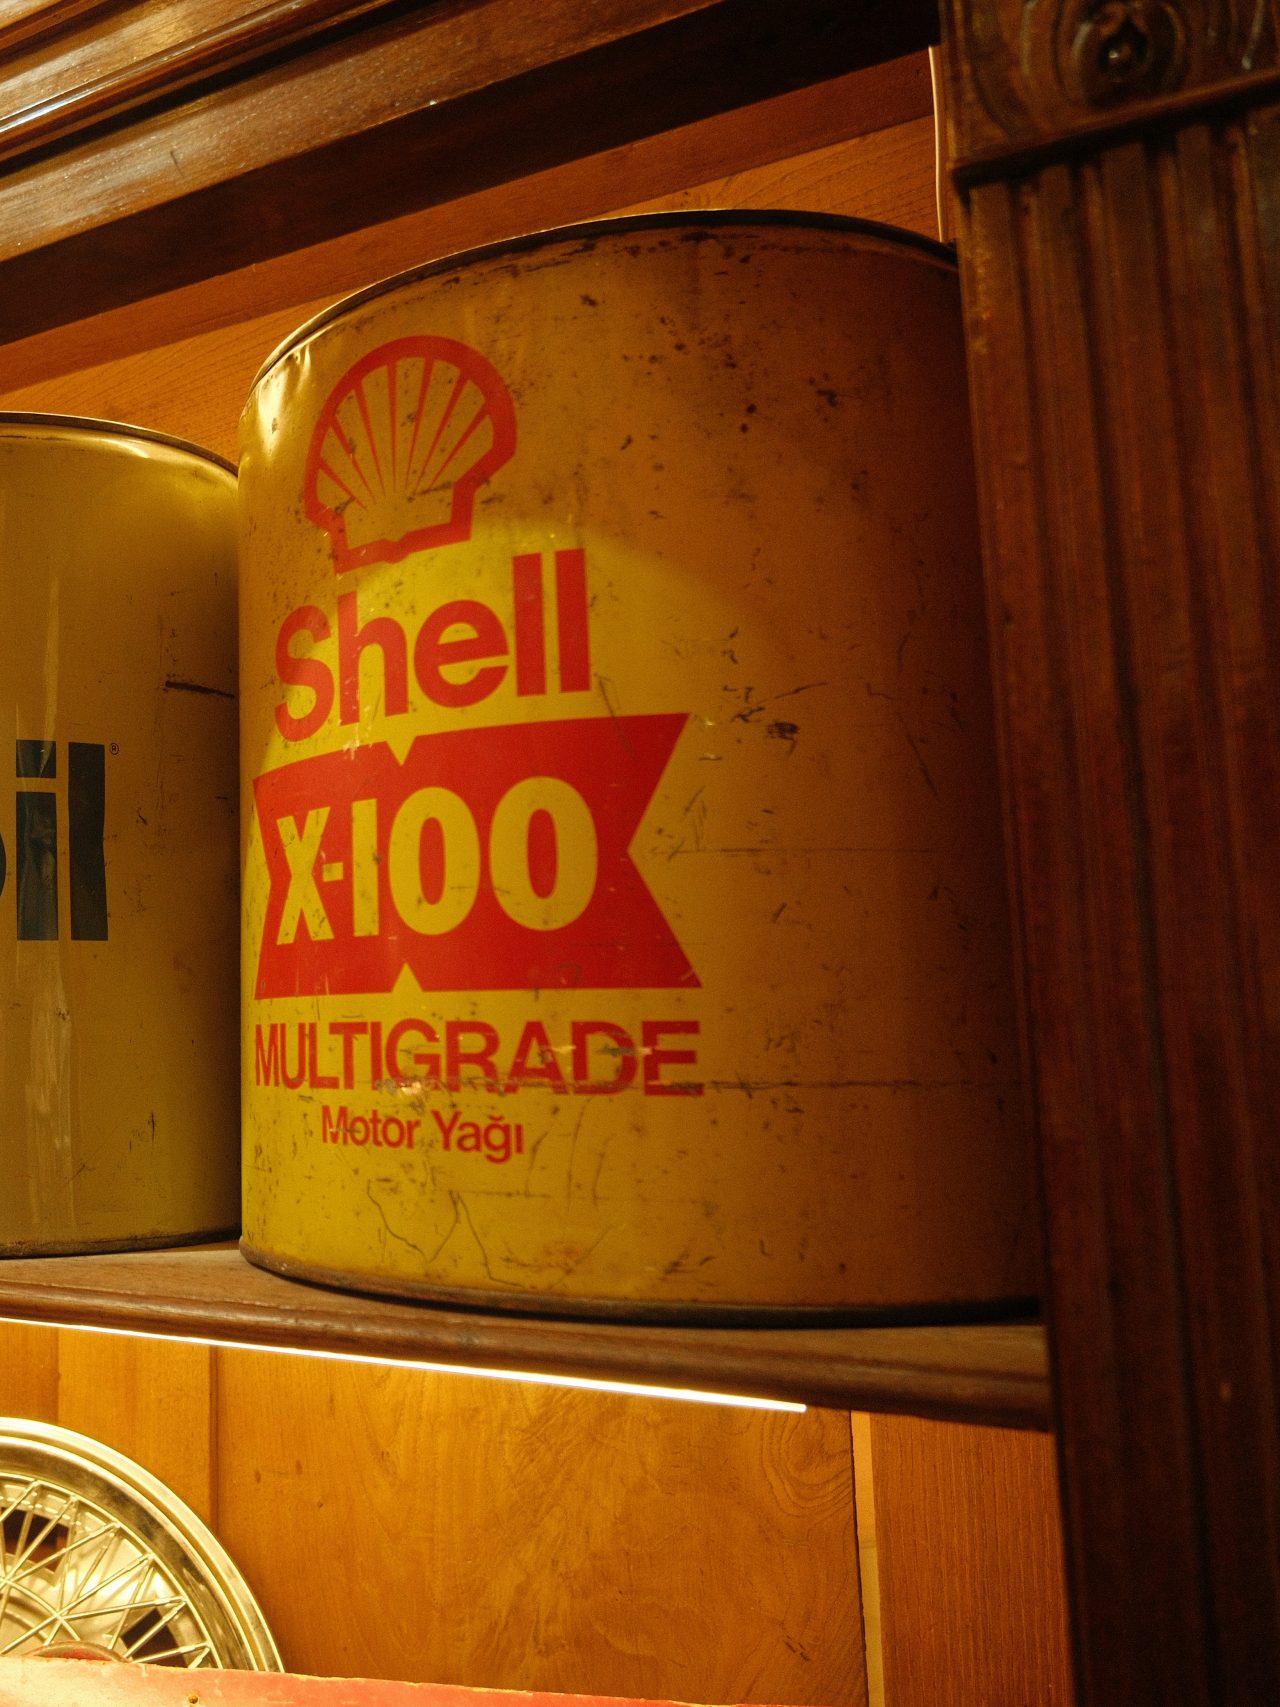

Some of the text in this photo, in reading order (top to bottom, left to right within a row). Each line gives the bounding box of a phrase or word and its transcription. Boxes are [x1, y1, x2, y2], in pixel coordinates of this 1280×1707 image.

[274, 547, 592, 742] Shell
[276, 776, 598, 945] X-100
[255, 1018, 704, 1097] MULTIGRADE
[321, 1105, 524, 1163] Motor Yağı
